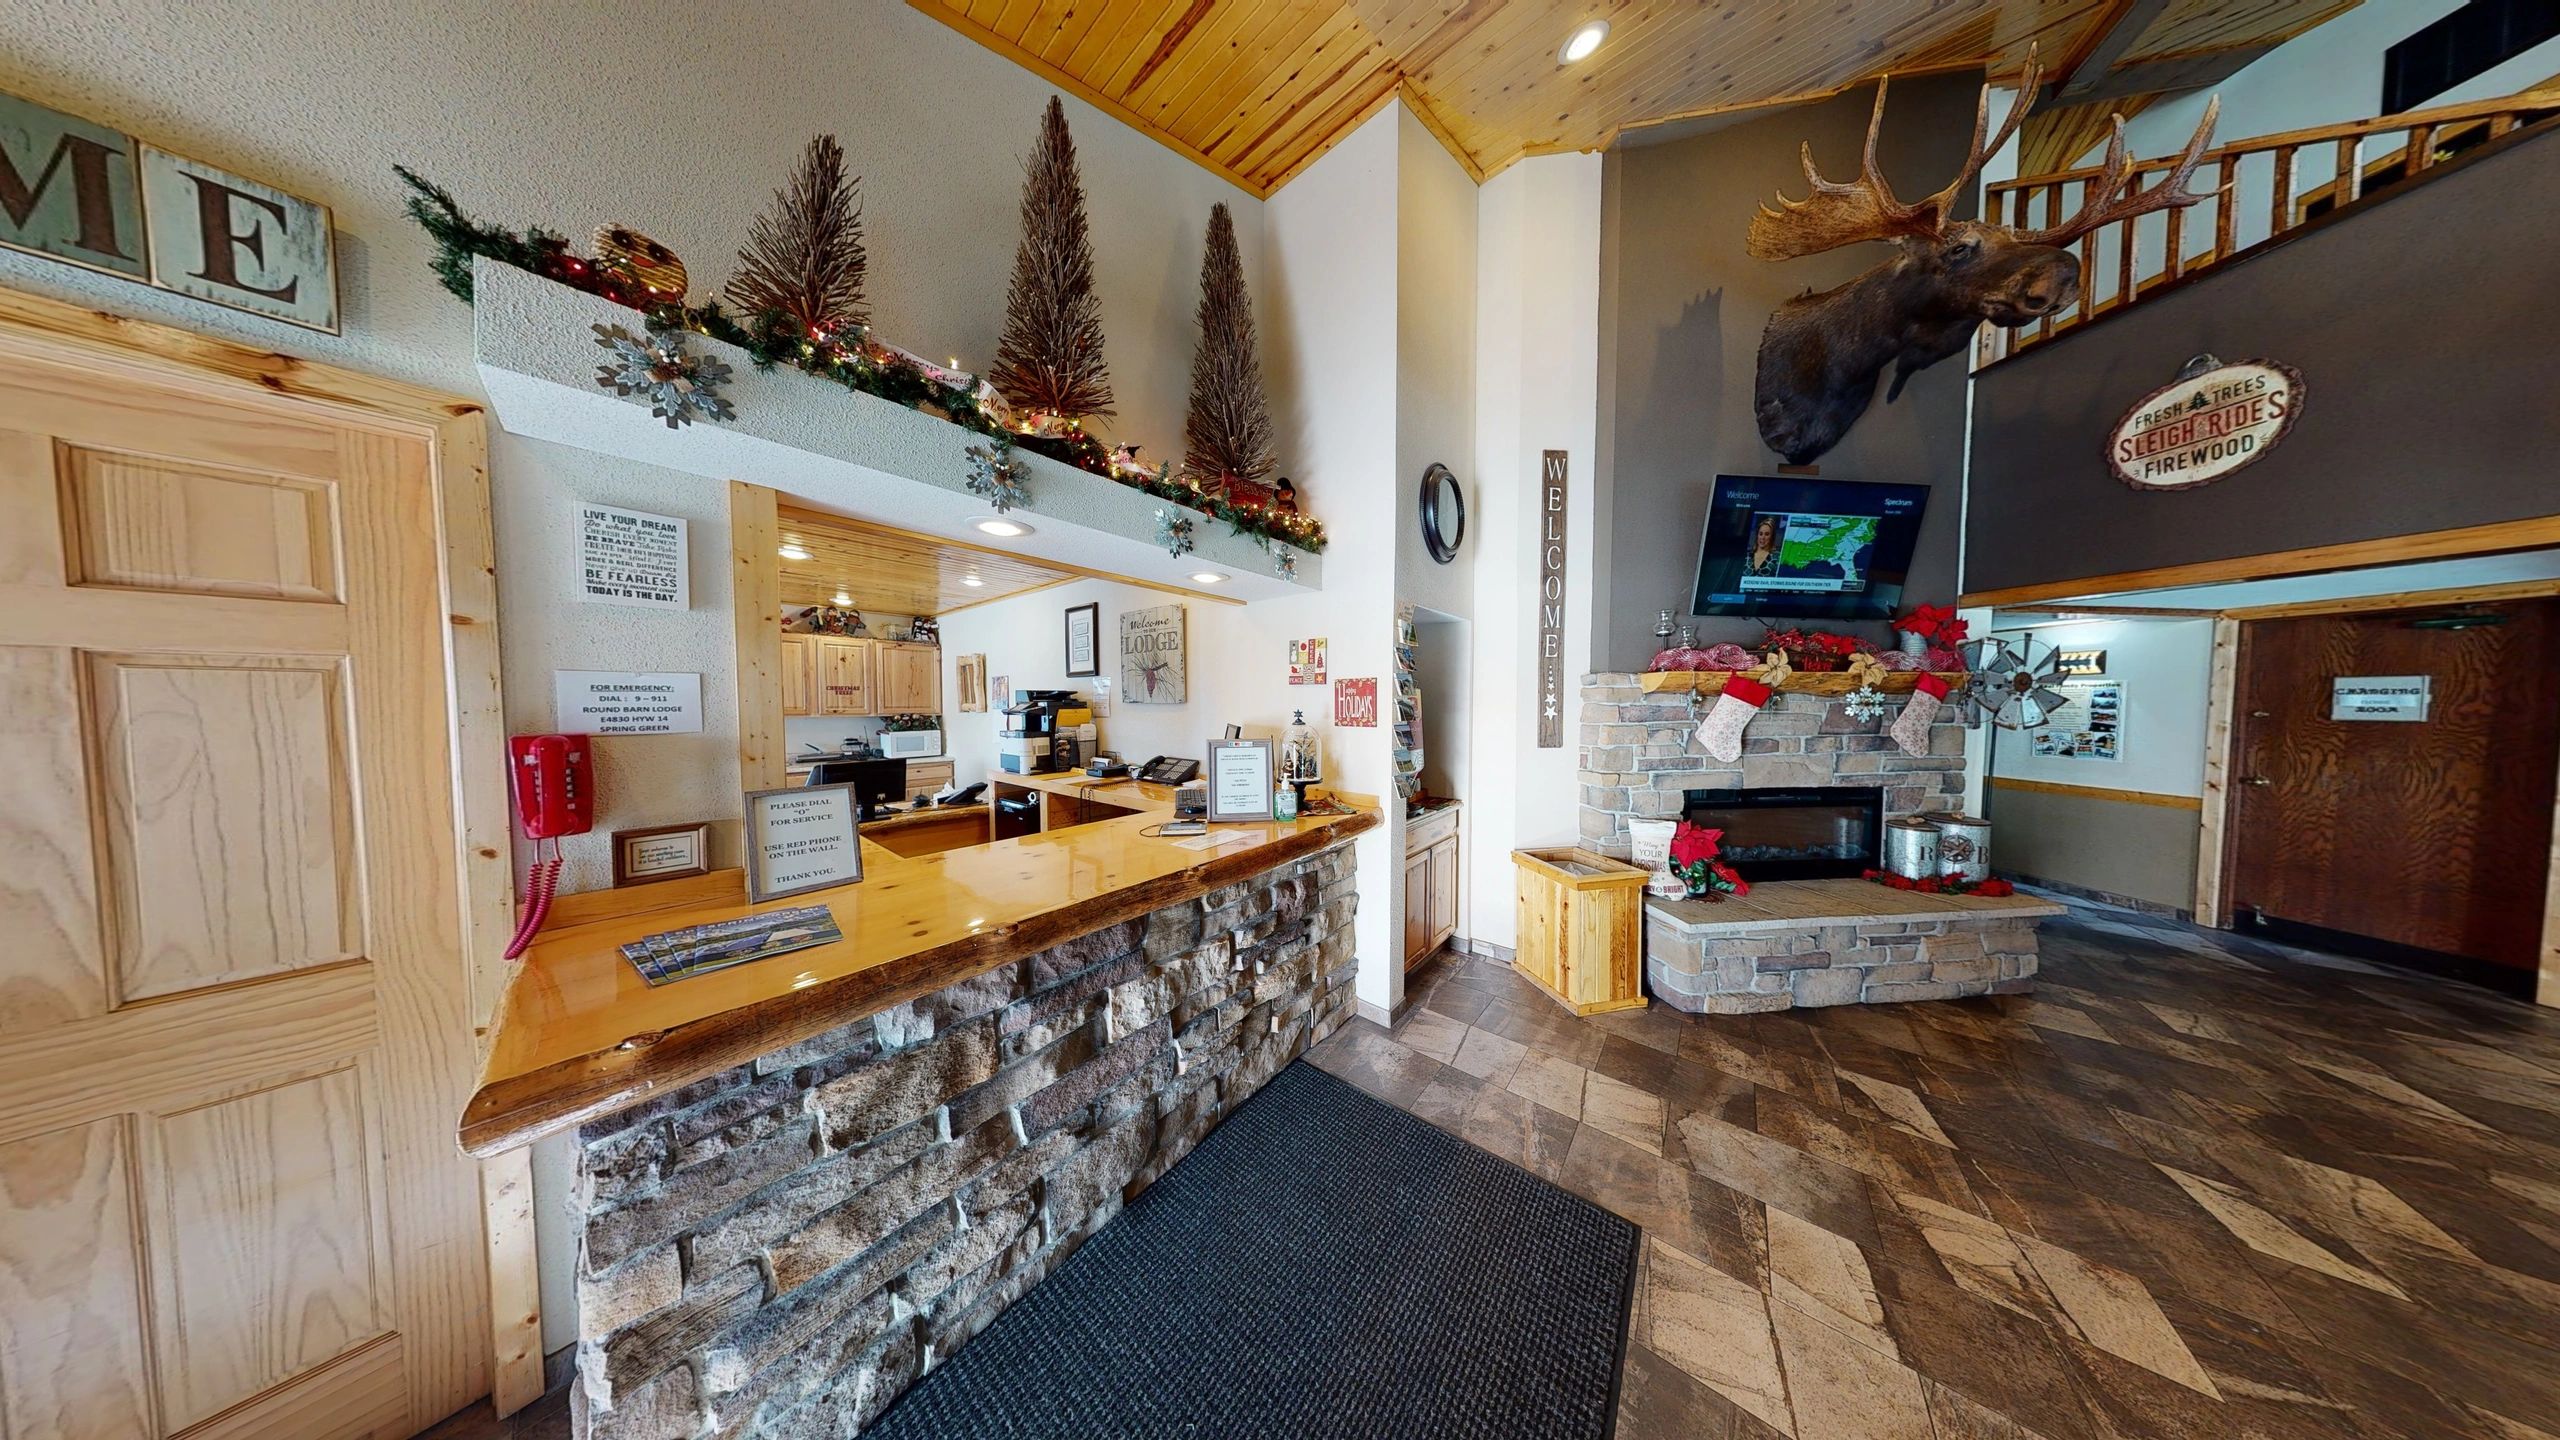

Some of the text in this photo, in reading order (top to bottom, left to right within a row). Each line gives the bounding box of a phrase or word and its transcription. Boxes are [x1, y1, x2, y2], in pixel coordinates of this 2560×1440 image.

[2135, 375, 2266, 429] FRESH TREES
[2120, 390, 2286, 463] SLEIGH RIDES
[2144, 434, 2254, 479] FIREWOOD
[1727, 490, 1759, 500] Welcome
[1884, 498, 1913, 507] Spectrum
[584, 510, 677, 533] LIVE YOUR DREAM
[584, 520, 601, 528] Do
[605, 523, 631, 533] what
[635, 529, 654, 537] you
[584, 541, 615, 552] CREATE
[601, 537, 635, 547] BRAVE
[1543, 457, 1567, 658] WELCOME
[586, 569, 677, 588] BE FEARLESS
[586, 585, 678, 603] TODAY IS THE DAY.
[1130, 615, 1170, 630] Welcome
[1124, 631, 1178, 655] LODGE
[590, 684, 674, 692] FOR EMERGENCY:
[770, 799, 832, 810] PLEASE DIAL
[770, 814, 834, 827] FOR SERVICE
[764, 835, 842, 852] USE RED PHONE
[769, 844, 838, 860] ON THE WALL.
[1640, 849, 1663, 858] YOUR
[1920, 846, 1933, 861] R
[1977, 846, 1989, 865] B
[1634, 858, 1666, 873] CHRISTMAS
[775, 867, 836, 884] THANK YOU.
[1663, 885, 1684, 894] BRIGHT
